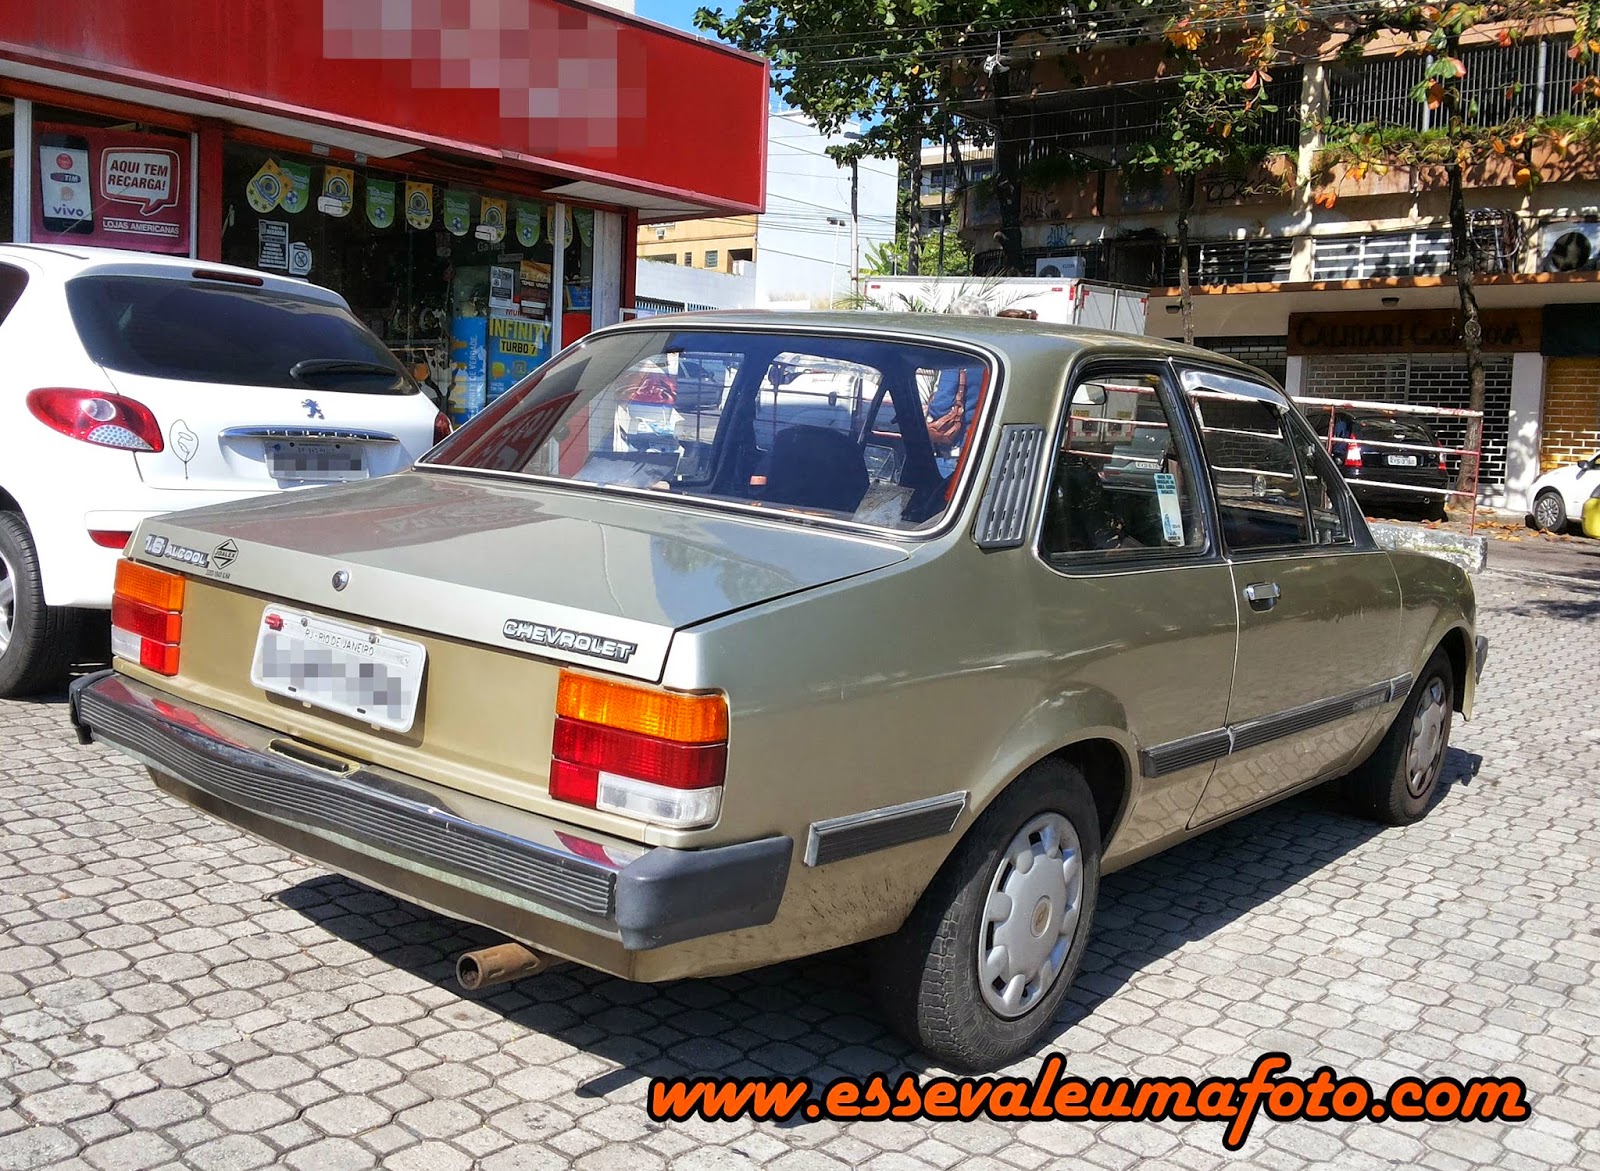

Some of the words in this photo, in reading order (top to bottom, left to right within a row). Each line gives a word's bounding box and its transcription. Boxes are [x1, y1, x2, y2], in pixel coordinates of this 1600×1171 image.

[109, 159, 140, 174] AQUI
[143, 163, 168, 177] TEM
[64, 174, 79, 182] TIM
[107, 174, 167, 191] RECARGA!
[52, 203, 84, 217] vivo
[103, 220, 129, 230] LOJAS
[130, 223, 180, 235] AMERICANAS
[489, 317, 551, 343] INFINITY
[501, 340, 529, 354] TURBO
[530, 345, 537, 355] 7
[164, 543, 208, 567] ALCOOL
[331, 635, 341, 648] DE
[342, 640, 375, 656] JANEIRO
[502, 619, 638, 663] CHEVROLET
